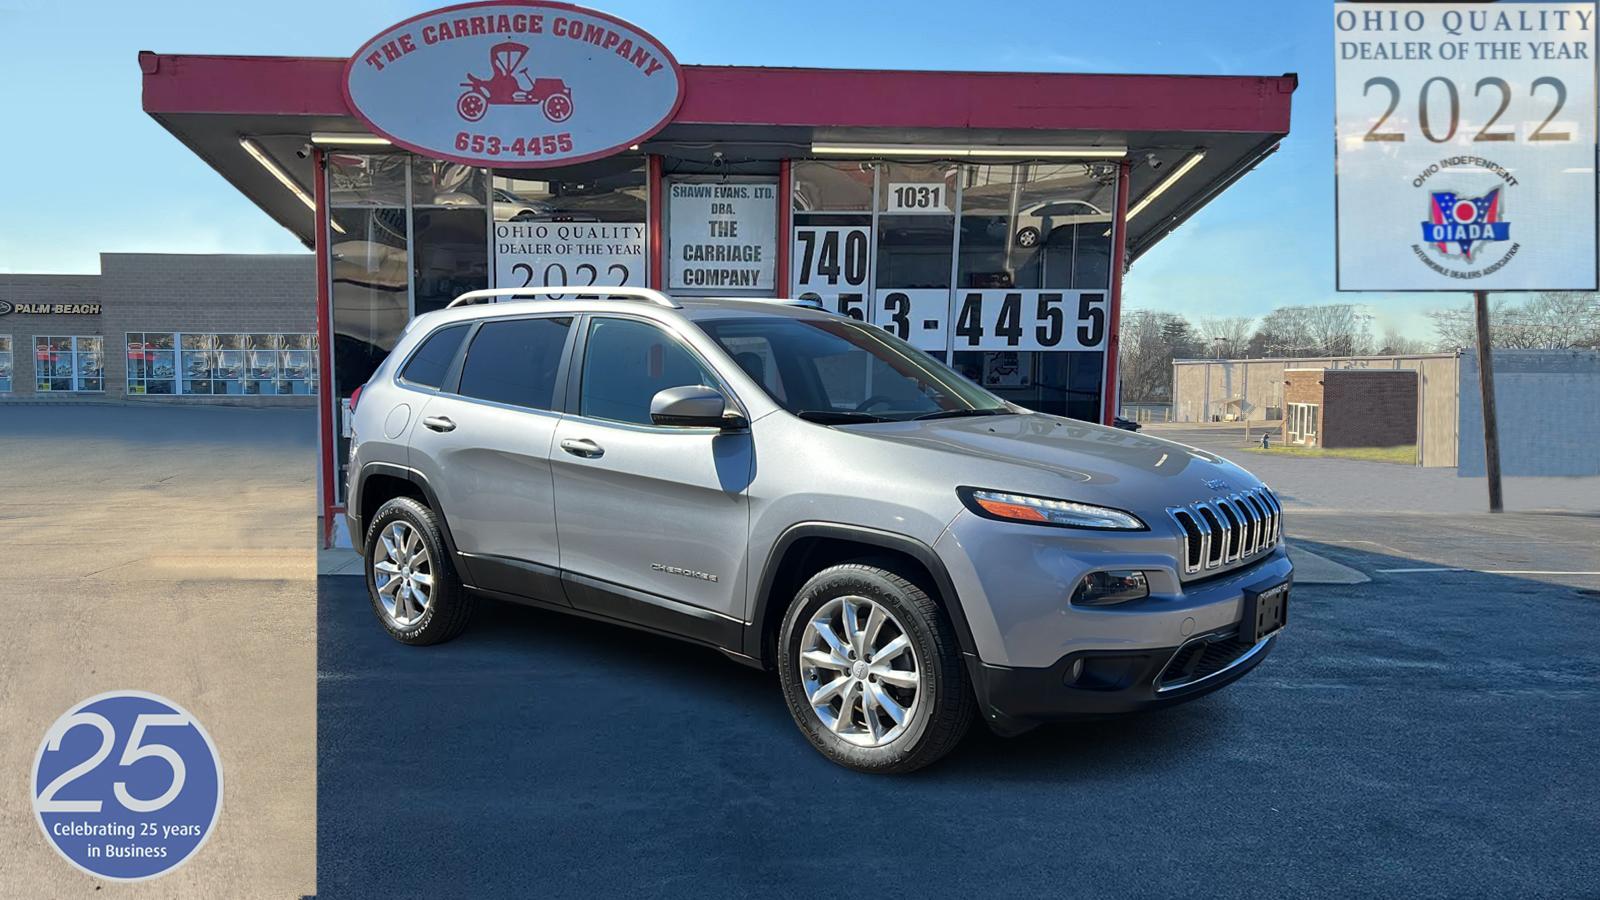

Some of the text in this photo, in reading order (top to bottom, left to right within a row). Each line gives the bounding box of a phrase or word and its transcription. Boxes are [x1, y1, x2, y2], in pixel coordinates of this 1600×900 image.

[1336, 9, 1593, 36] OHIO QUALITY
[365, 14, 664, 77] THE CARRIAGE COMPANY
[1340, 42, 1589, 60] DEALER OF THE YEAR
[1362, 76, 1571, 143] 2022
[455, 131, 574, 158] 653-4455
[1412, 155, 1519, 188] OHIO INDEPENDENT
[672, 186, 713, 199] SHAWN
[754, 187, 775, 199] LTD.
[894, 186, 941, 208] 1031
[711, 203, 736, 215] DBA.
[497, 226, 645, 241] OHIO QUALITY
[709, 221, 738, 237] THE
[1432, 224, 1495, 241] OIADA
[499, 243, 641, 255] DEALER OF THE YEAR
[682, 244, 762, 262] CARRIAGE
[797, 230, 868, 286] 740
[511, 263, 630, 300] 2022
[682, 268, 760, 286] COMPANY
[1450, 269, 1483, 280] DEALERS
[15, 303, 50, 314] PALM
